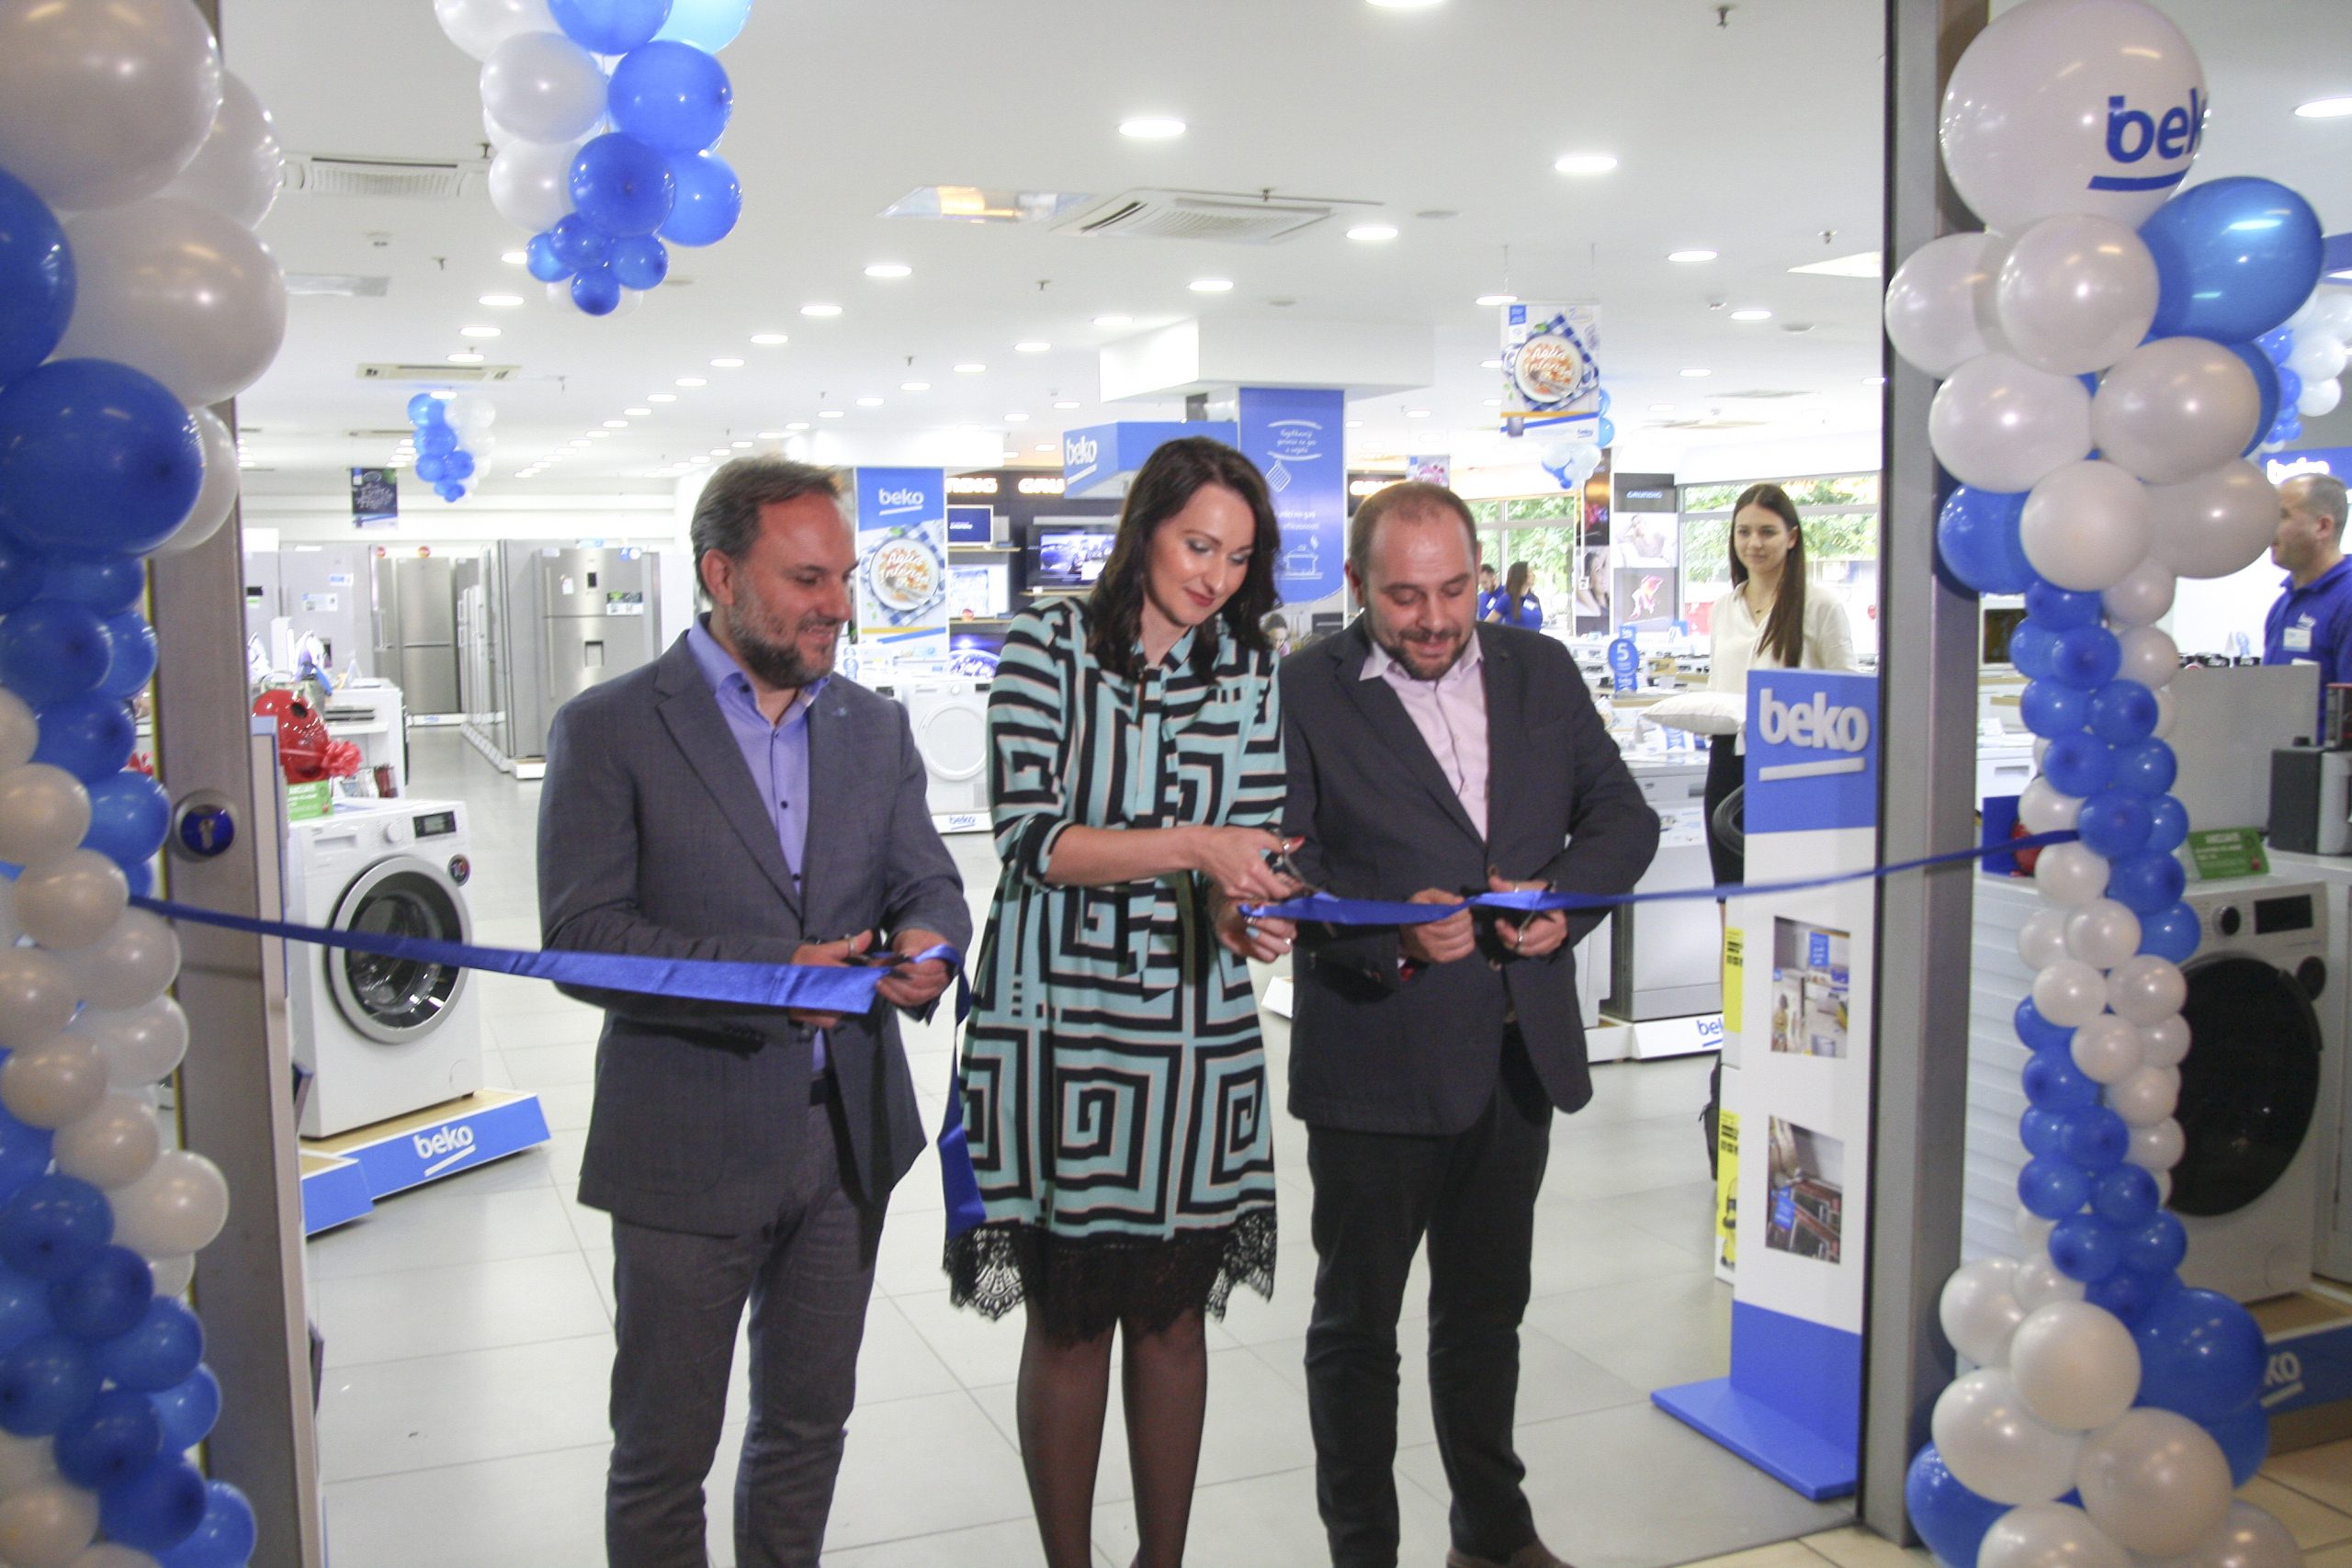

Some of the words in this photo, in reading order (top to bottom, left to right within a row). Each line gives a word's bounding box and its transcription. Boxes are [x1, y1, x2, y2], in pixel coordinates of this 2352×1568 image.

[2106, 87, 2207, 164] bek
[1067, 435, 1097, 466] beko
[878, 488, 924, 505] beko
[1617, 644, 1629, 660] 5
[1759, 688, 1869, 752] beko
[413, 1125, 474, 1159] beko
[2263, 1351, 2301, 1387] ko
